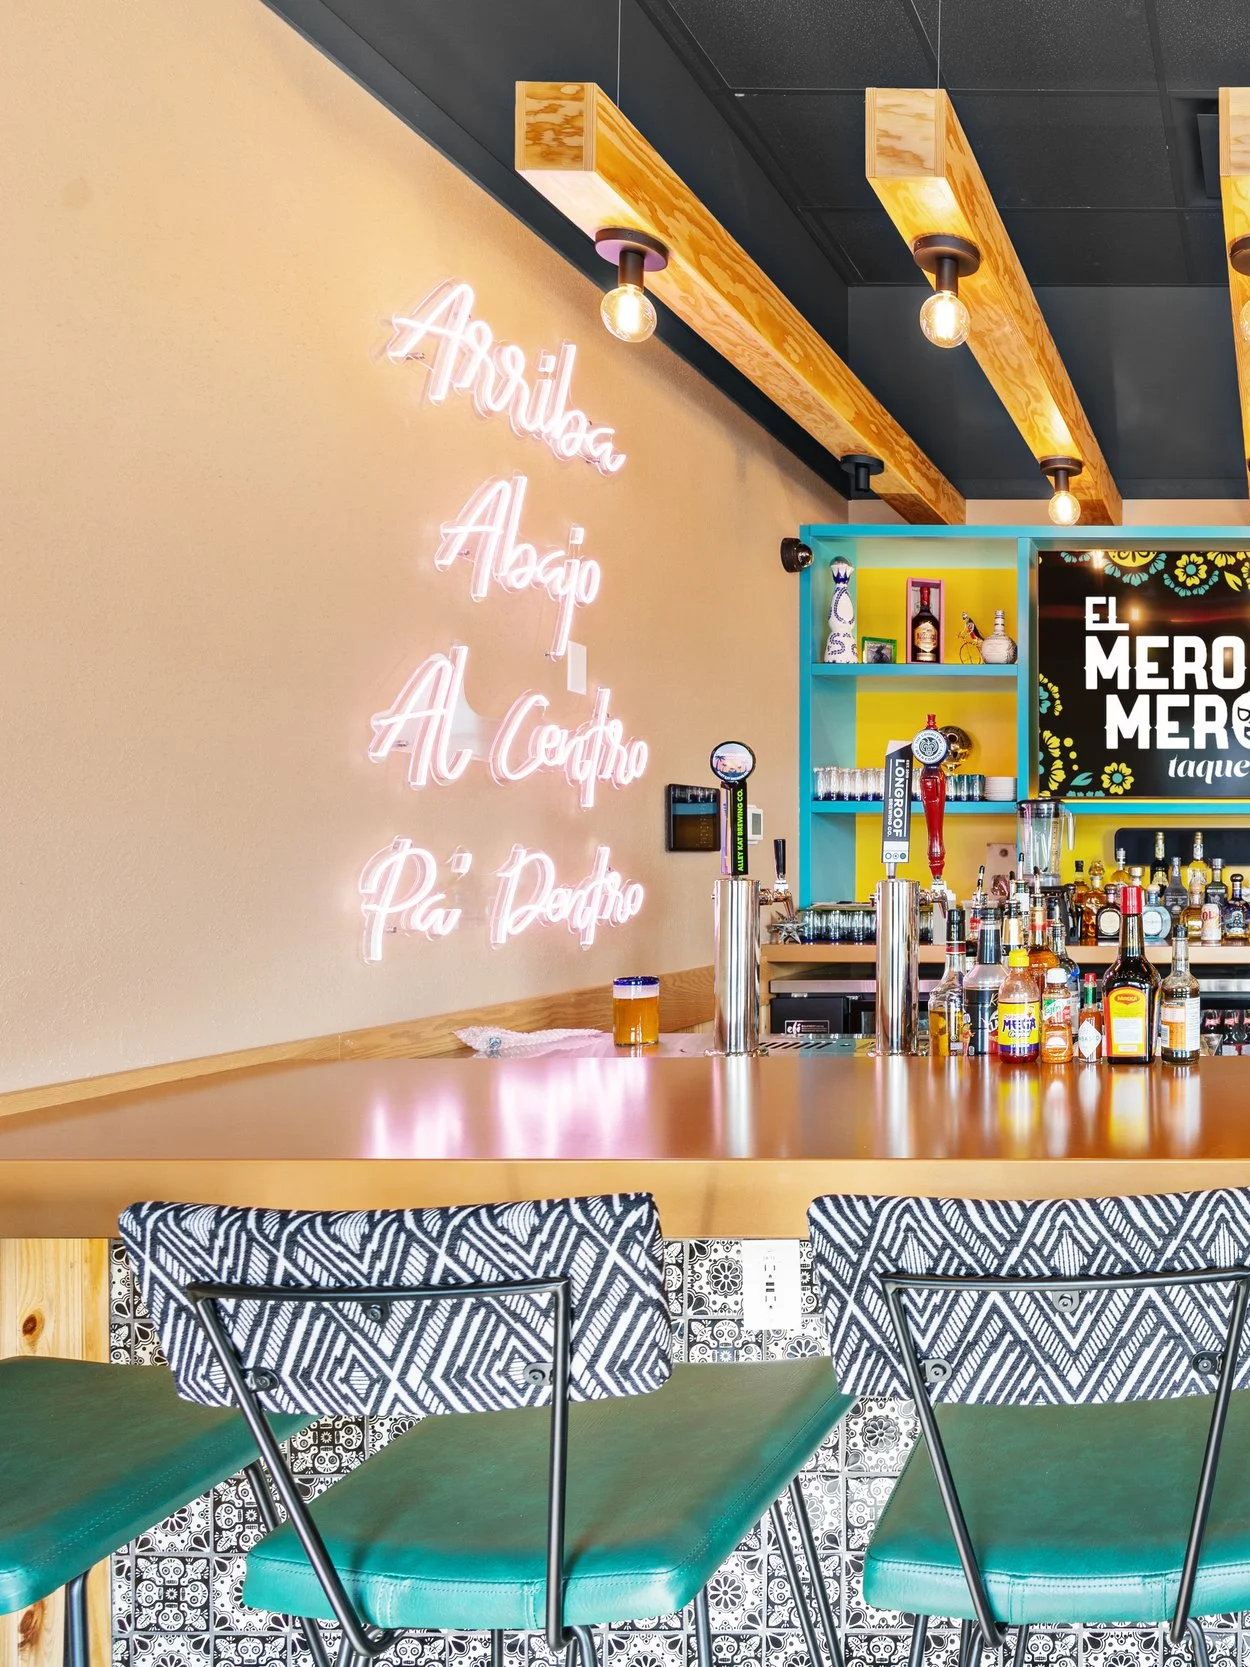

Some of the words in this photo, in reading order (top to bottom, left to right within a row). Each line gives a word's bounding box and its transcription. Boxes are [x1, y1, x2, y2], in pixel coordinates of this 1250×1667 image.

[387, 277, 627, 476] Arriba
[434, 470, 601, 661] Abajo
[1085, 596, 1130, 631] EL
[1084, 635, 1247, 690] MERO
[368, 641, 473, 790] Al
[490, 686, 650, 811] Centro
[892, 758, 905, 837] LONGROOF
[490, 844, 646, 951] Dentro
